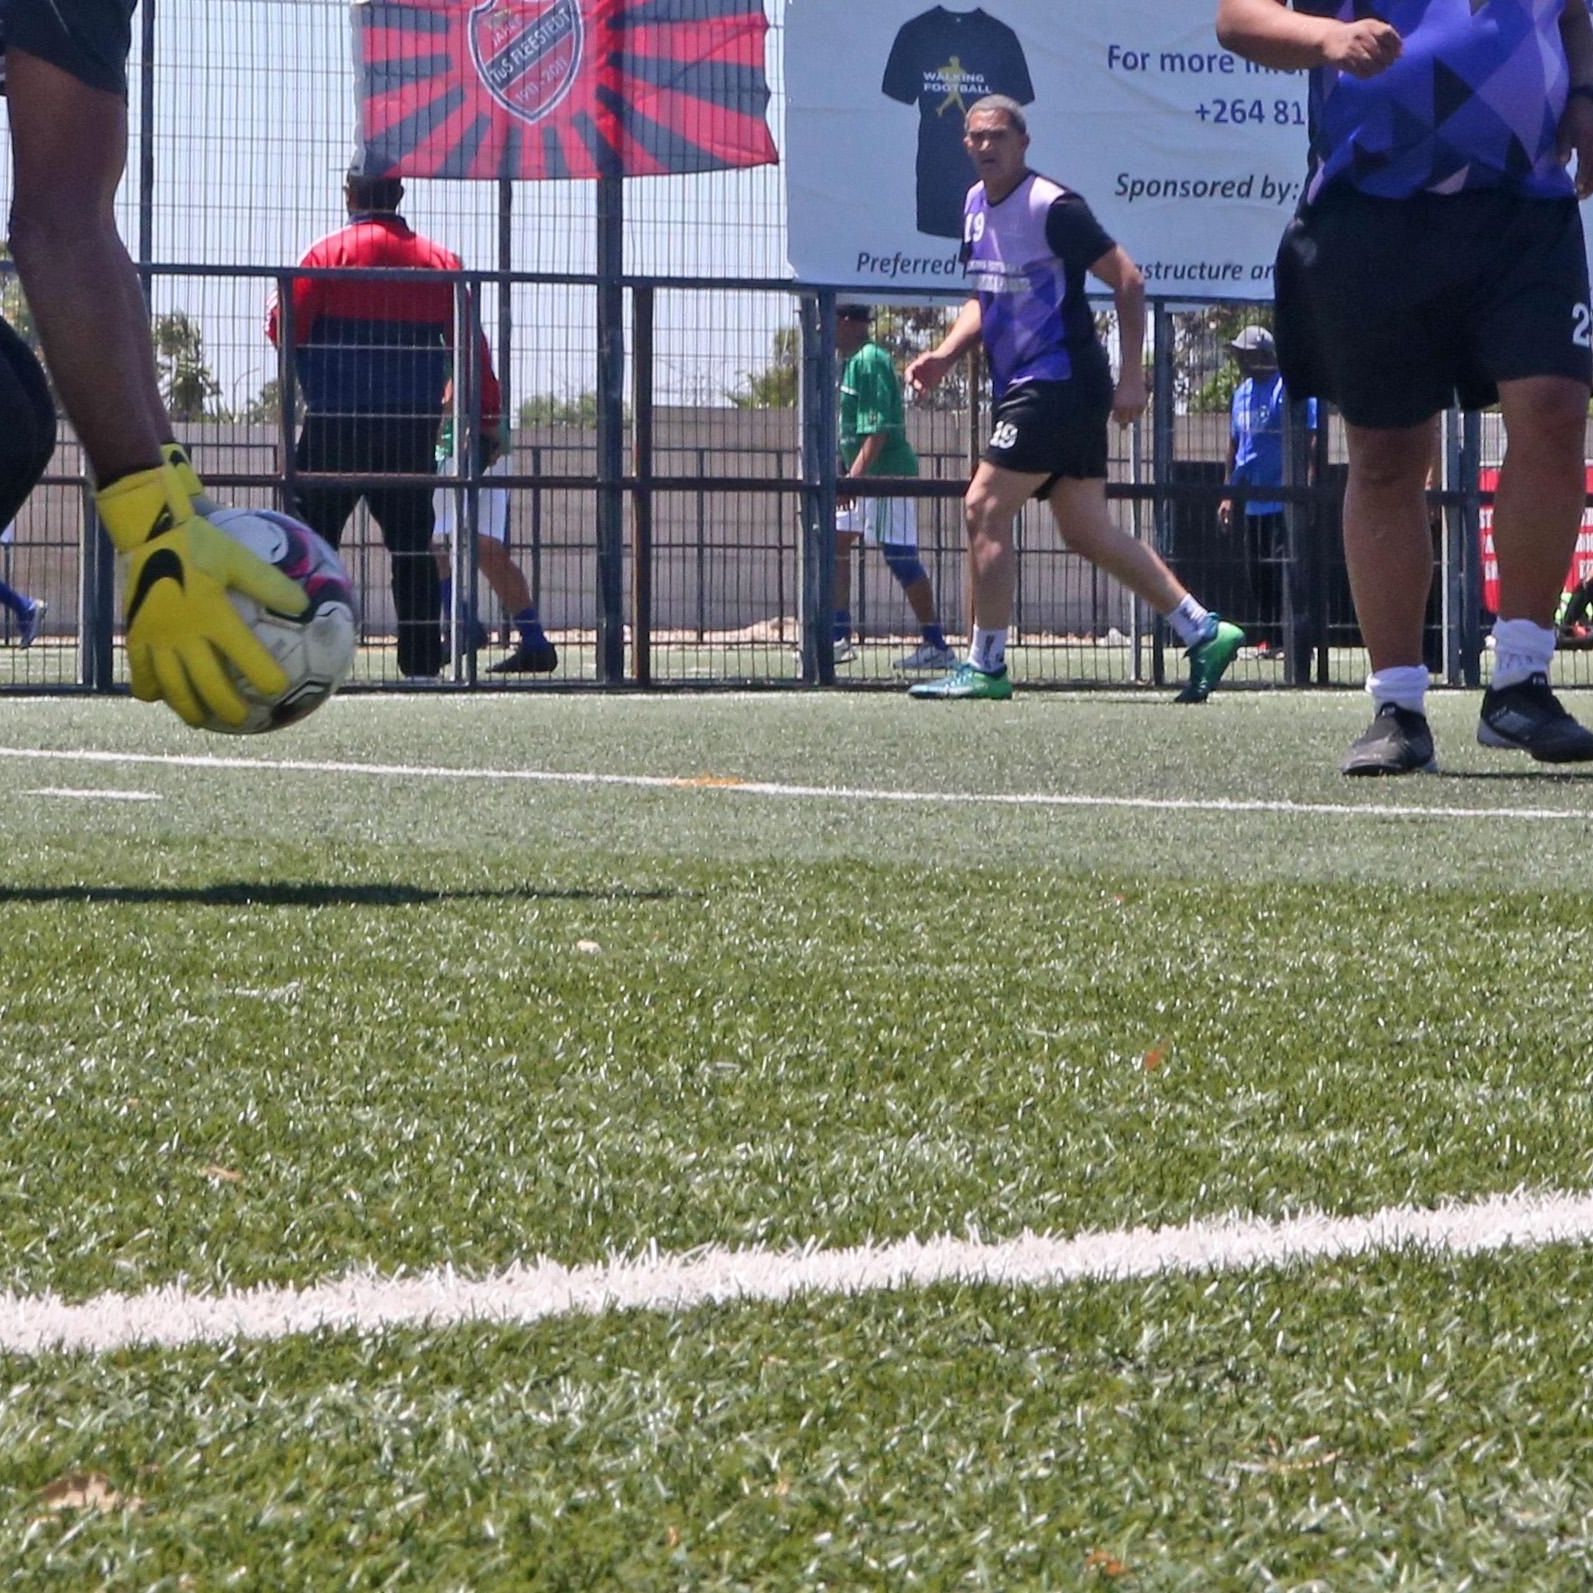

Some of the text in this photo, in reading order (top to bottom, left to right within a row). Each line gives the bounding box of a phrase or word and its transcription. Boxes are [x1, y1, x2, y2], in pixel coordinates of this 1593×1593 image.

[509, 6, 572, 66] FLEESTEDT
[1107, 44, 1150, 72] For
[1159, 52, 1235, 74] more
[922, 71, 985, 84] WALKING
[922, 82, 993, 94] FOOTBALL
[1194, 98, 1266, 124] +264
[1114, 172, 1300, 205] Sponsored by:
[963, 210, 986, 244] 19
[856, 251, 957, 279] Preferred
[1250, 263, 1276, 280] an
